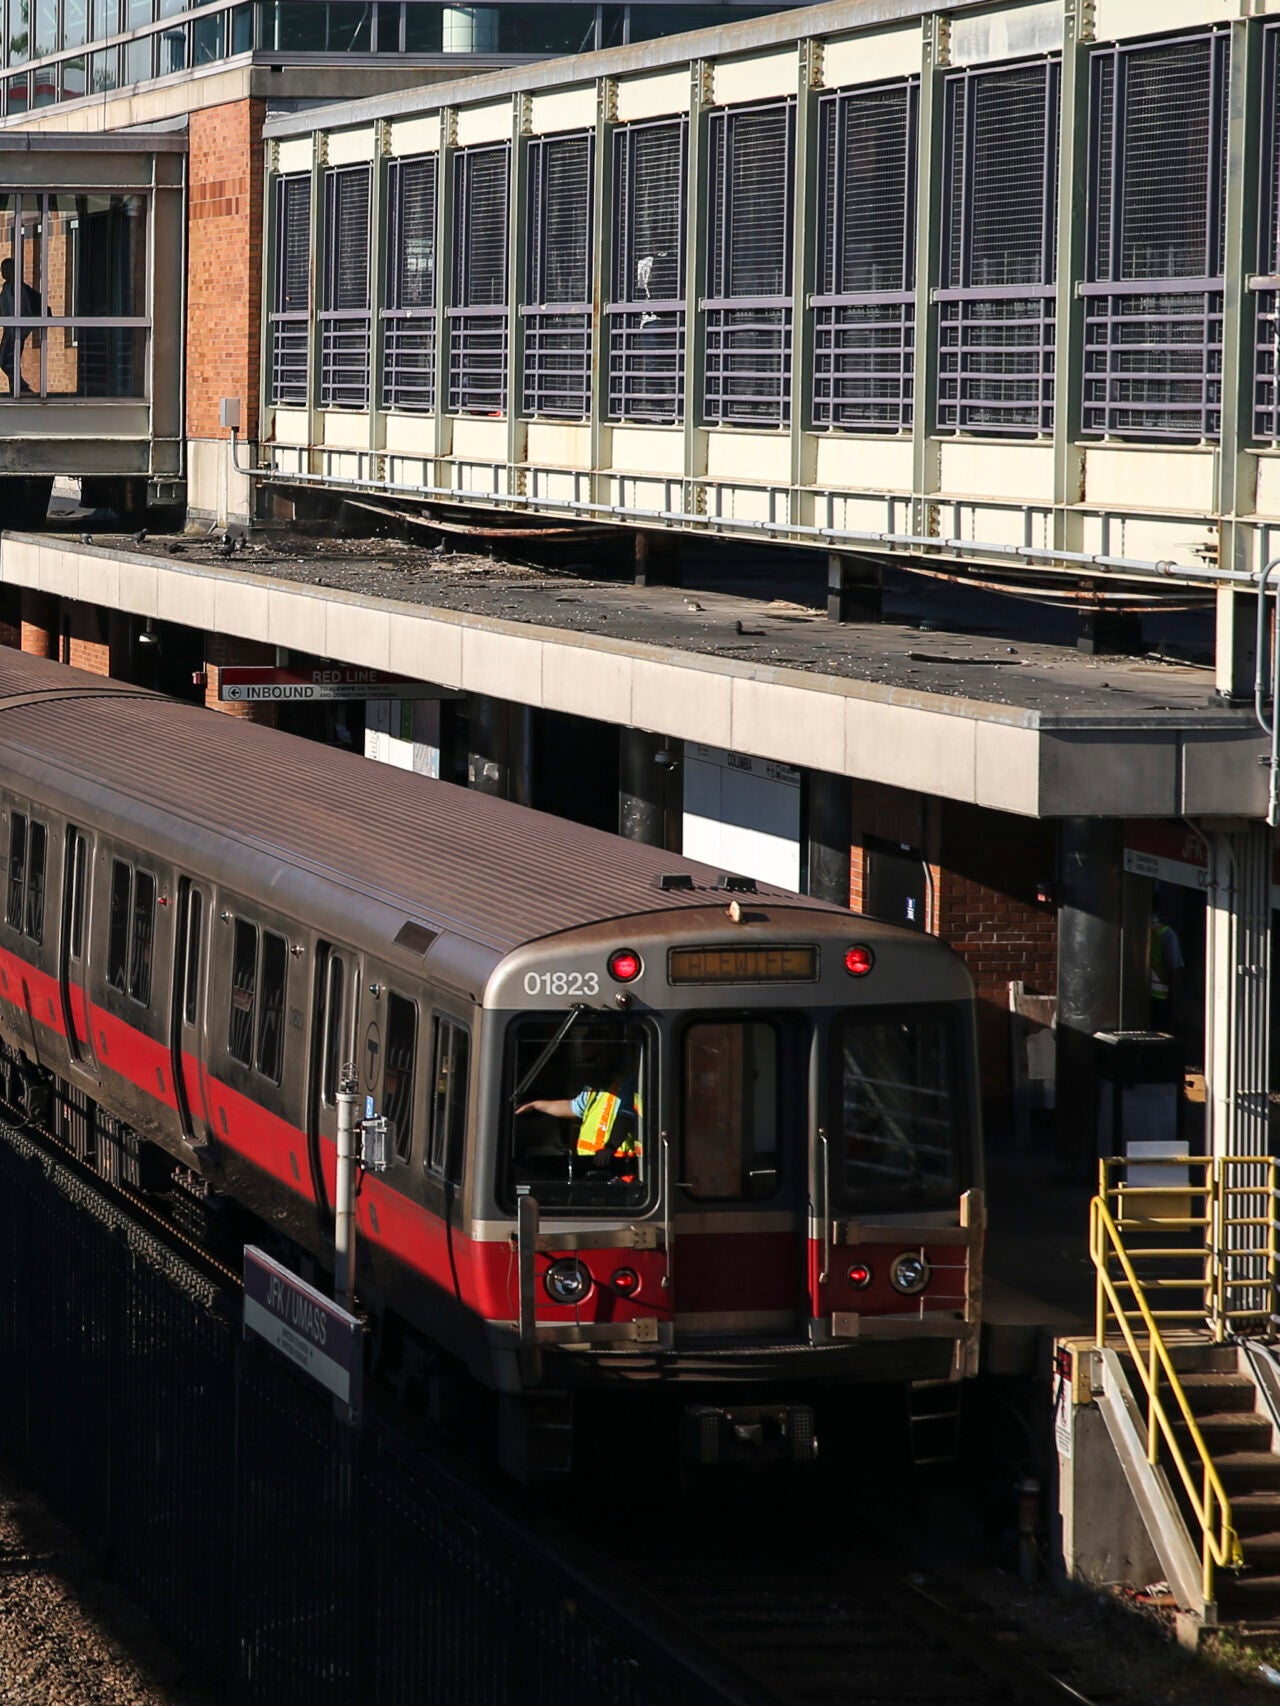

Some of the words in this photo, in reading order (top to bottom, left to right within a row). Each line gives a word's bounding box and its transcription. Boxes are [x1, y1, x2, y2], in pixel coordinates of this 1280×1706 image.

[312, 670, 341, 682] RED
[346, 670, 377, 682] LINE
[246, 686, 314, 699] INBOUND
[688, 951, 795, 978] ALEWIFE
[523, 971, 599, 996] 01823
[266, 1275, 284, 1314] JFK
[292, 1293, 326, 1345] UMASS
